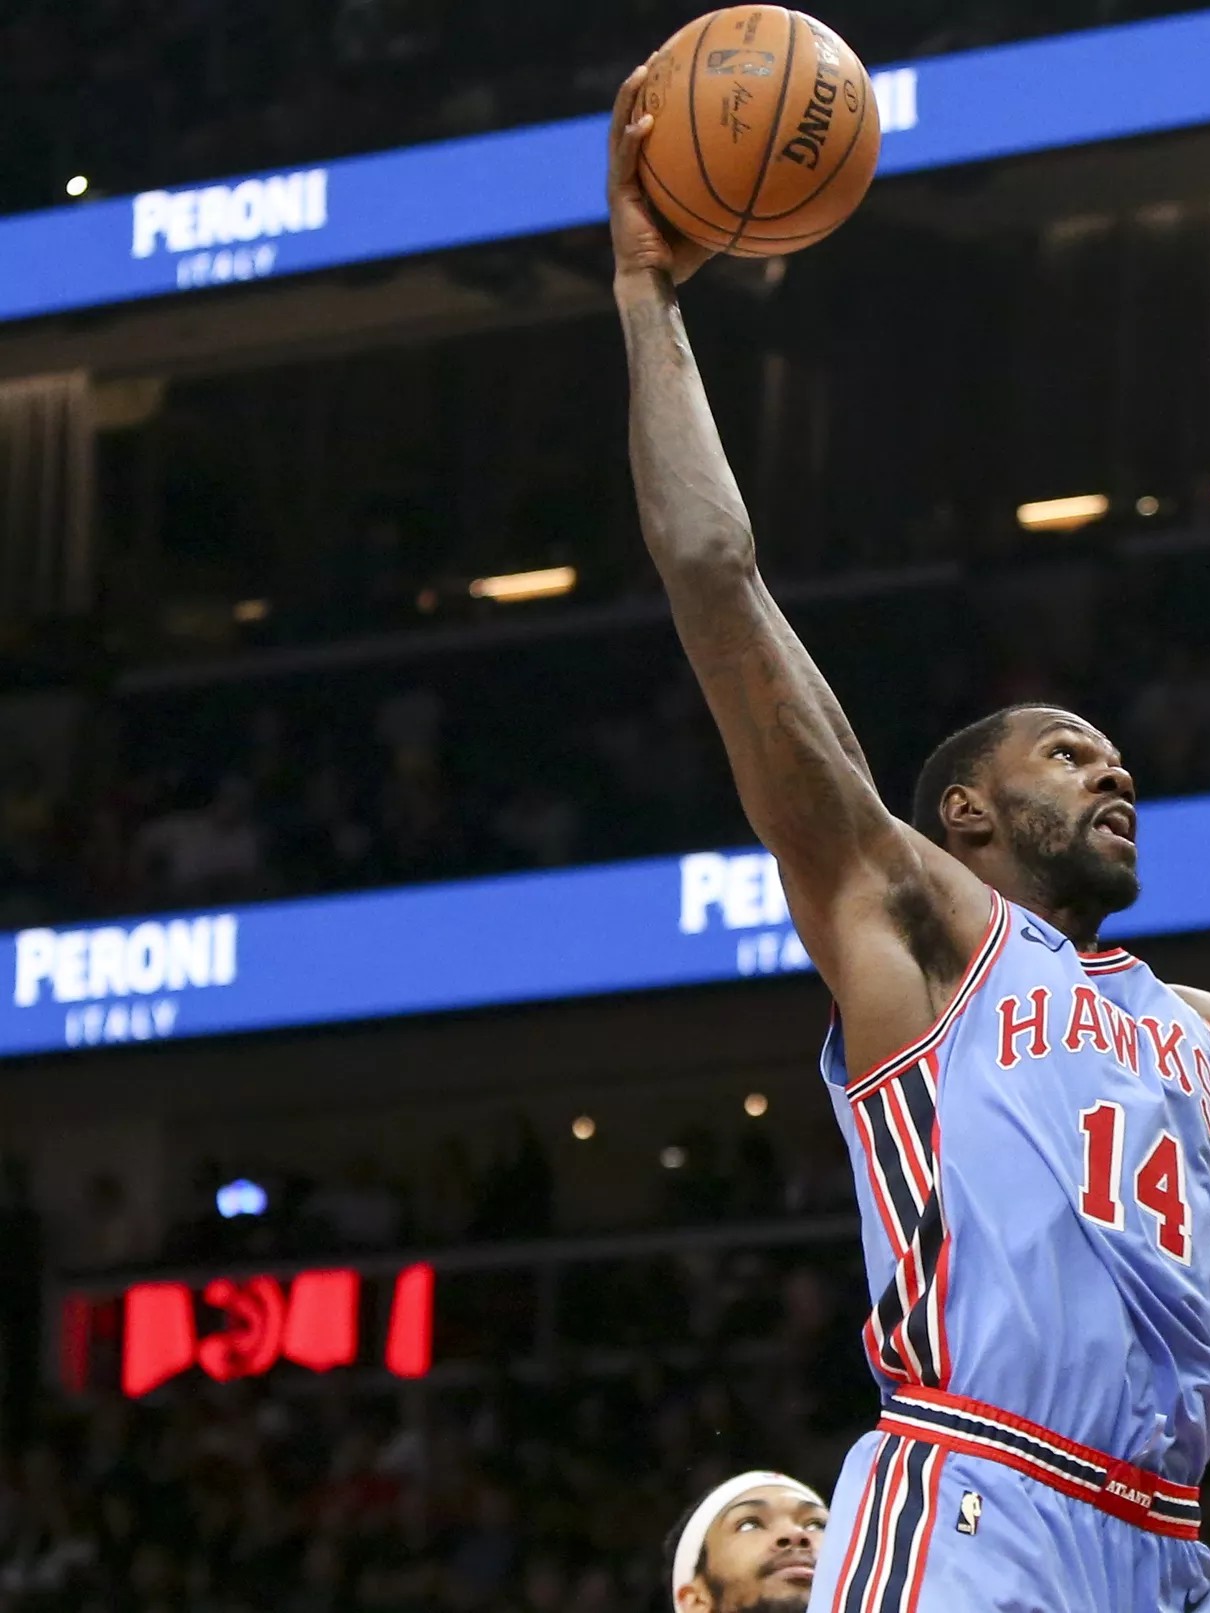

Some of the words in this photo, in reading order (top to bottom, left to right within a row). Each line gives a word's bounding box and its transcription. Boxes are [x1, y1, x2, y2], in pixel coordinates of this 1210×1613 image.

[131, 168, 328, 259] PERONI
[176, 243, 276, 290] ITALY
[15, 913, 238, 1008] PERONI
[64, 997, 179, 1048] ITALY
[1078, 1098, 1193, 1268] 14
